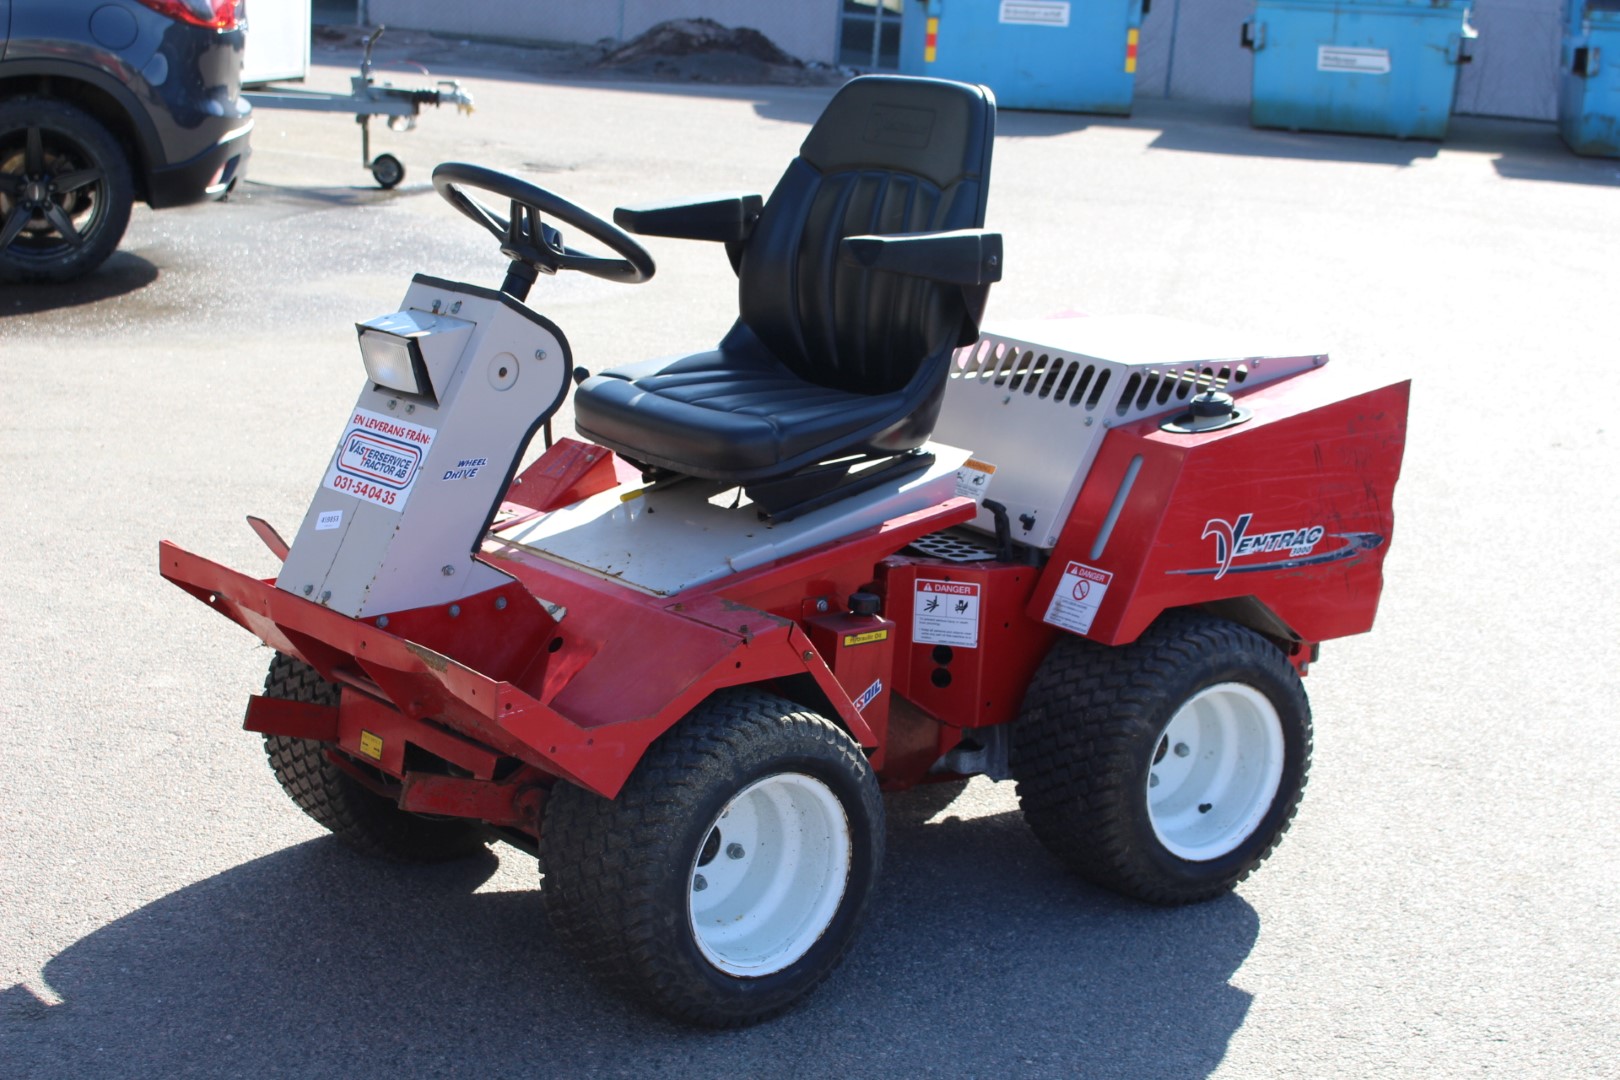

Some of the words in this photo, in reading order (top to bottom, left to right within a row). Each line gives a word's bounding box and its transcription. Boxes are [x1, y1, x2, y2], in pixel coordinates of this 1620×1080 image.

[353, 414, 366, 426] EN
[364, 417, 406, 438] LEVERANS
[406, 428, 431, 444] FRÅN:
[359, 457, 394, 475] TRACTOR
[394, 469, 408, 478] AB
[457, 458, 487, 467] WHEEL
[442, 468, 478, 480] DRIVE
[1078, 568, 1106, 582] DANGER
[934, 584, 971, 594] DANGER
[853, 679, 881, 710] SOIL
